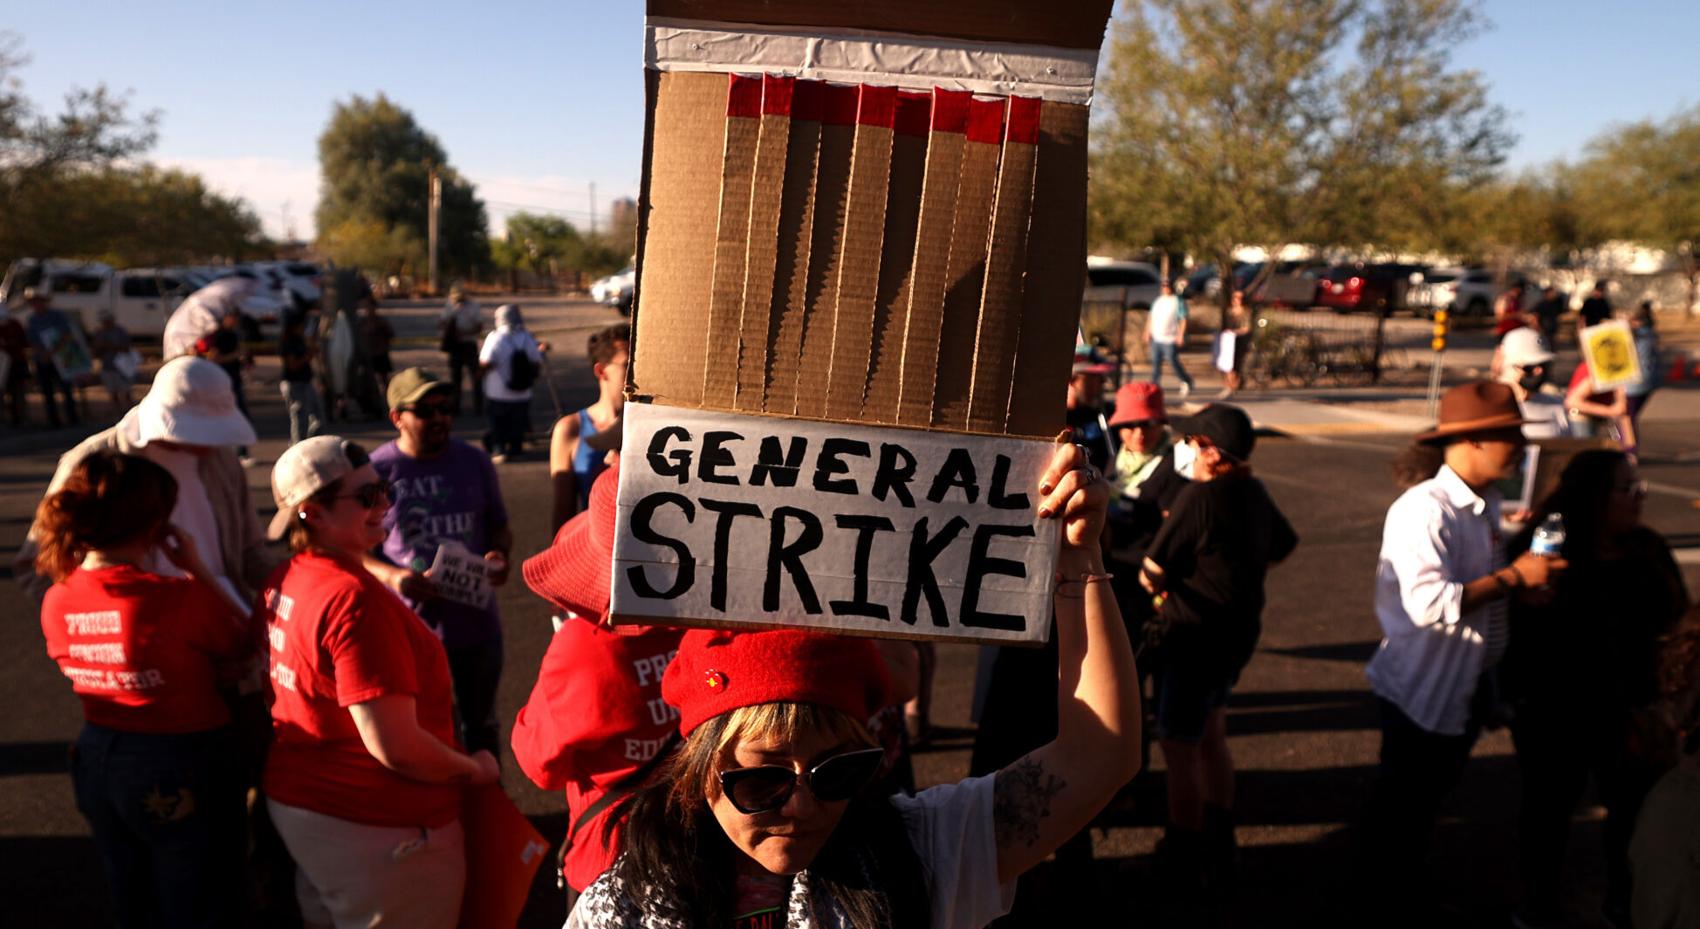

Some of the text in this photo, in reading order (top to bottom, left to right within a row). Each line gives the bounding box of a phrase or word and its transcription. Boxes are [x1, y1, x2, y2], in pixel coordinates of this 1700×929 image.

[646, 426, 1031, 510] GENERAL
[441, 568, 483, 592] NOT
[626, 492, 1036, 632] STRIKE
